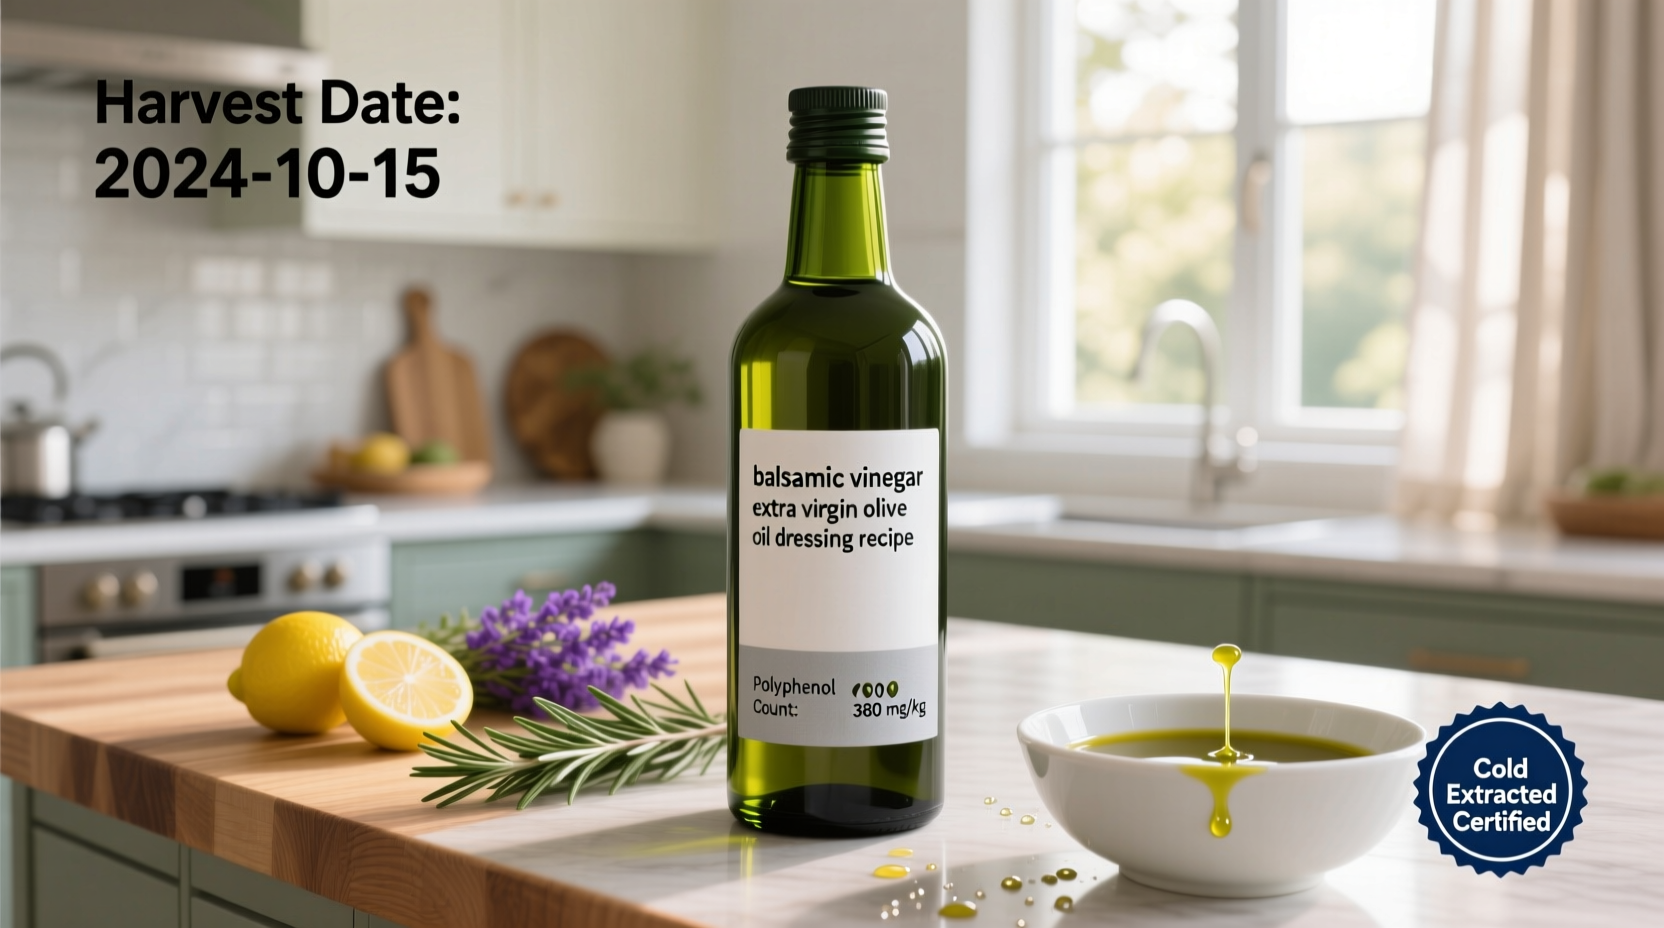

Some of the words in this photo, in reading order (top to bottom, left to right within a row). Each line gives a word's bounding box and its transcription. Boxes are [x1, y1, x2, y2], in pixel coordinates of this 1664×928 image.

[753, 464, 845, 489] balsamic
[849, 465, 924, 494] vinegar
[752, 499, 797, 518] extra
[801, 498, 858, 525] virgin
[863, 498, 907, 518] olive
[752, 525, 771, 547] oil
[775, 527, 854, 554] dressing
[859, 528, 914, 553] recipe
[753, 675, 836, 698] Polyphenol
[753, 698, 798, 718] Count:
[853, 702, 882, 718] 380
[886, 698, 926, 720] mg/kg
